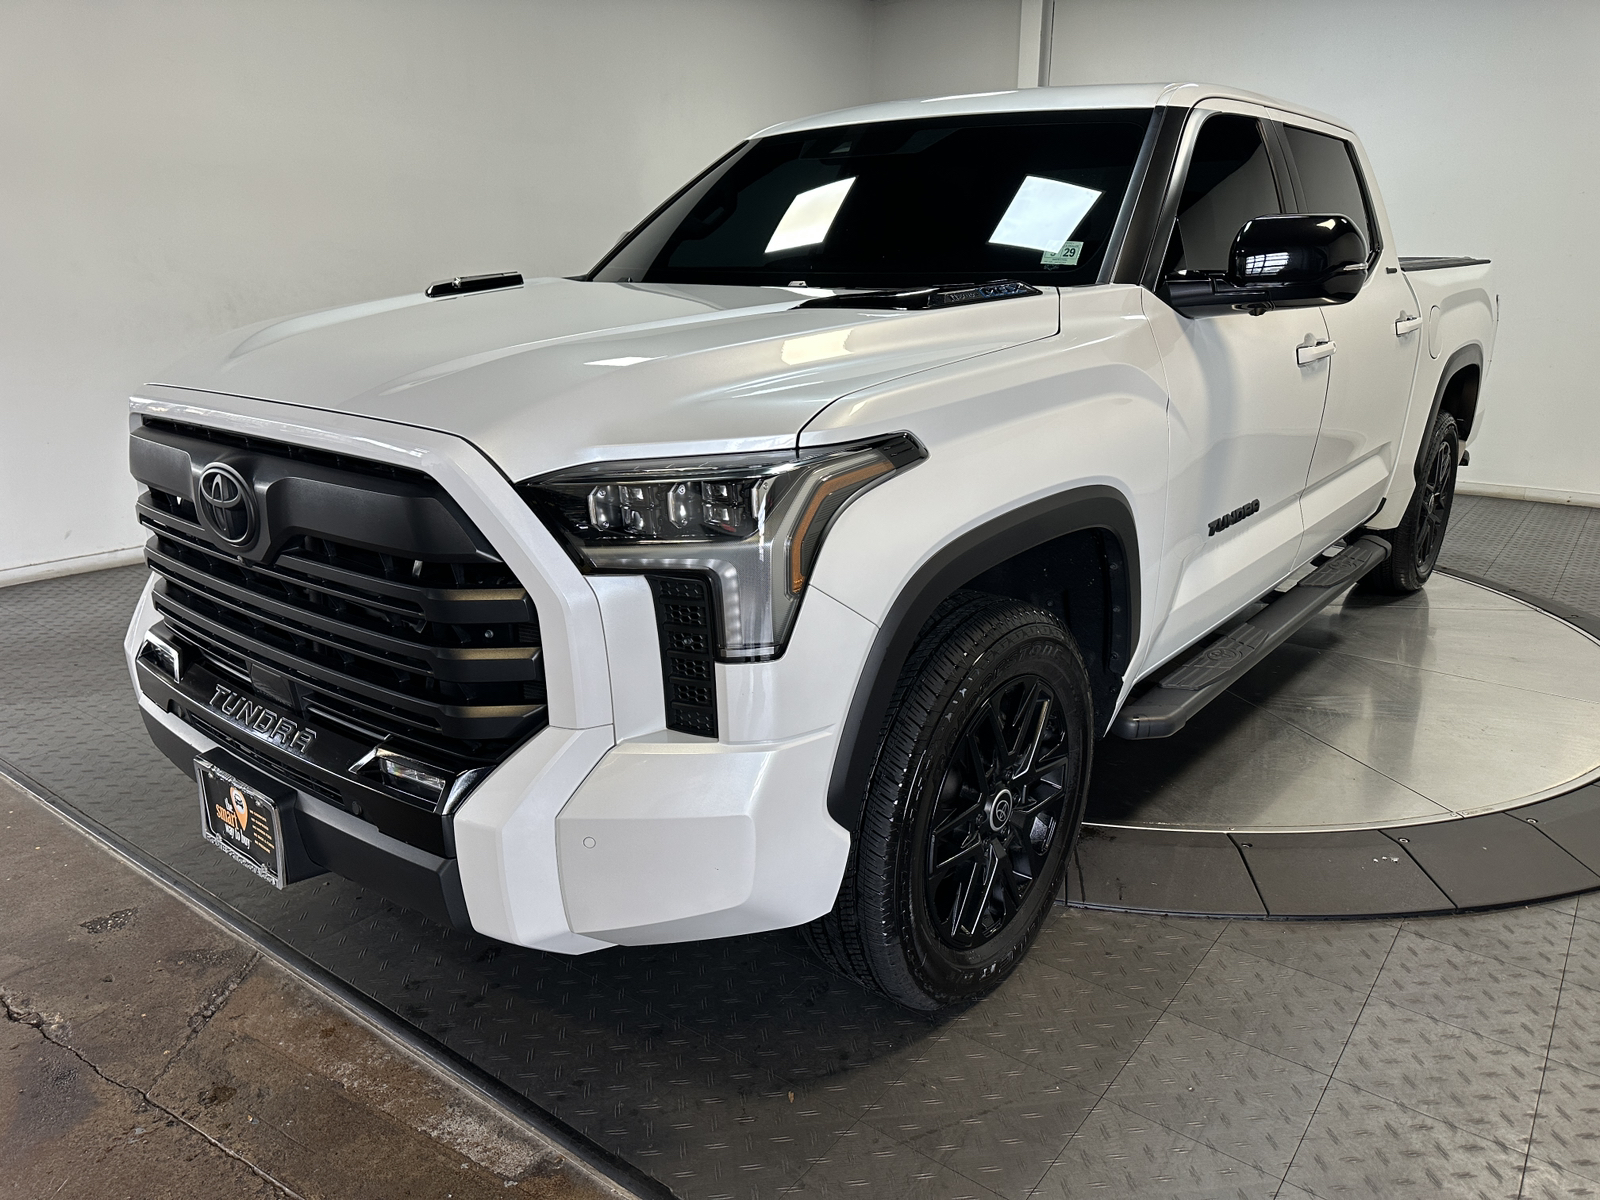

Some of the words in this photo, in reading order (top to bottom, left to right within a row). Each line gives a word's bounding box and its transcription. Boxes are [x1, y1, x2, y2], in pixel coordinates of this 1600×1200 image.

[1062, 247, 1076, 258] 29
[1207, 498, 1261, 537] TUNDRA
[208, 684, 317, 753] TUNDRA
[215, 803, 239, 830] smart
